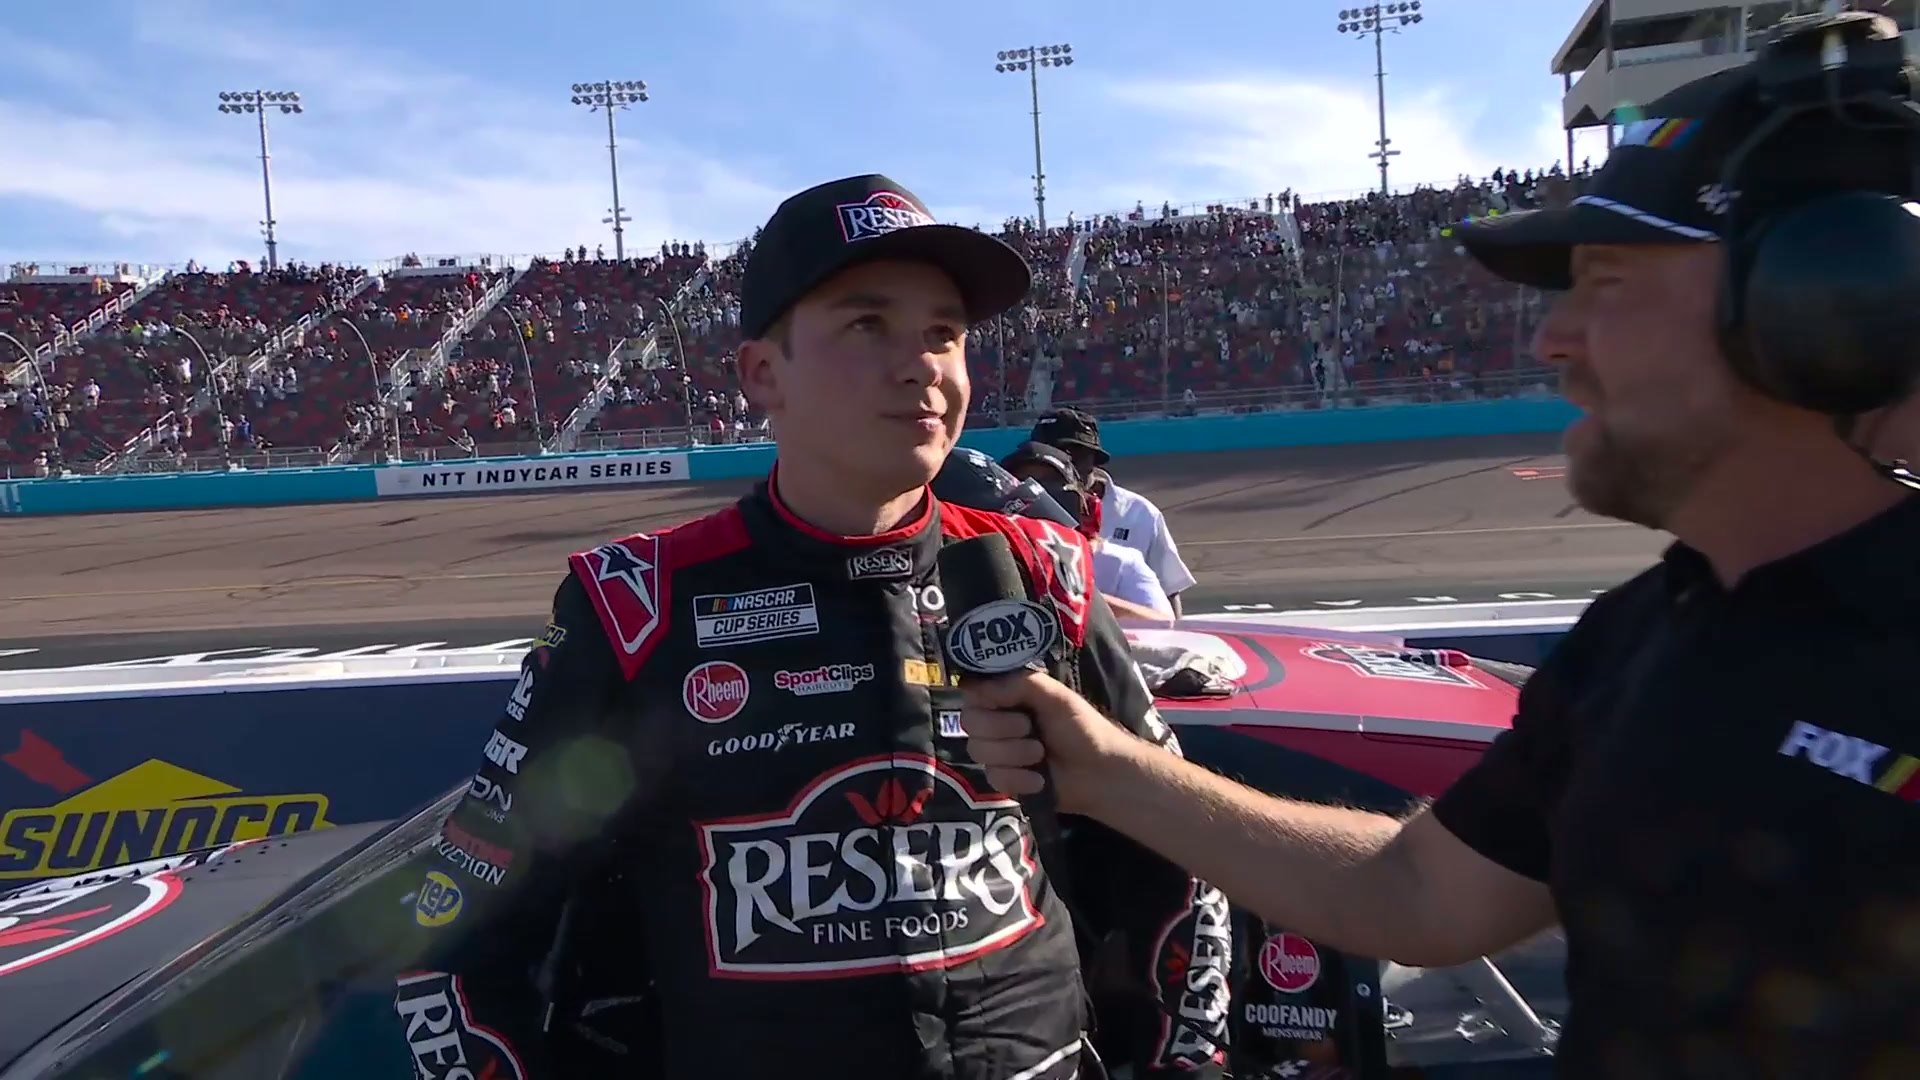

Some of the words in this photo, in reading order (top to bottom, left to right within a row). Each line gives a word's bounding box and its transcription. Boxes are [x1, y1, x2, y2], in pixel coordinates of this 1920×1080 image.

[422, 471, 466, 487] NTT
[476, 465, 579, 484] INDYCAR
[590, 460, 673, 478] SERIES
[733, 590, 796, 611] NASCAR
[713, 617, 745, 635] CUP
[747, 611, 801, 631] SERIES
[968, 610, 1035, 650] FOX
[974, 637, 1038, 662] SPORTS
[692, 666, 745, 712] Rheem
[798, 681, 850, 694] HAIRCUTS
[1777, 719, 1891, 785] FOX
[1, 801, 320, 871] SUNOCO
[729, 811, 1028, 955] RESER'S
[812, 918, 874, 945] FINE
[885, 907, 969, 940] FOODS
[1267, 934, 1316, 984] Rheem
[1244, 1003, 1338, 1030] COOFANDY
[1262, 1026, 1323, 1041] MENSWEAR
